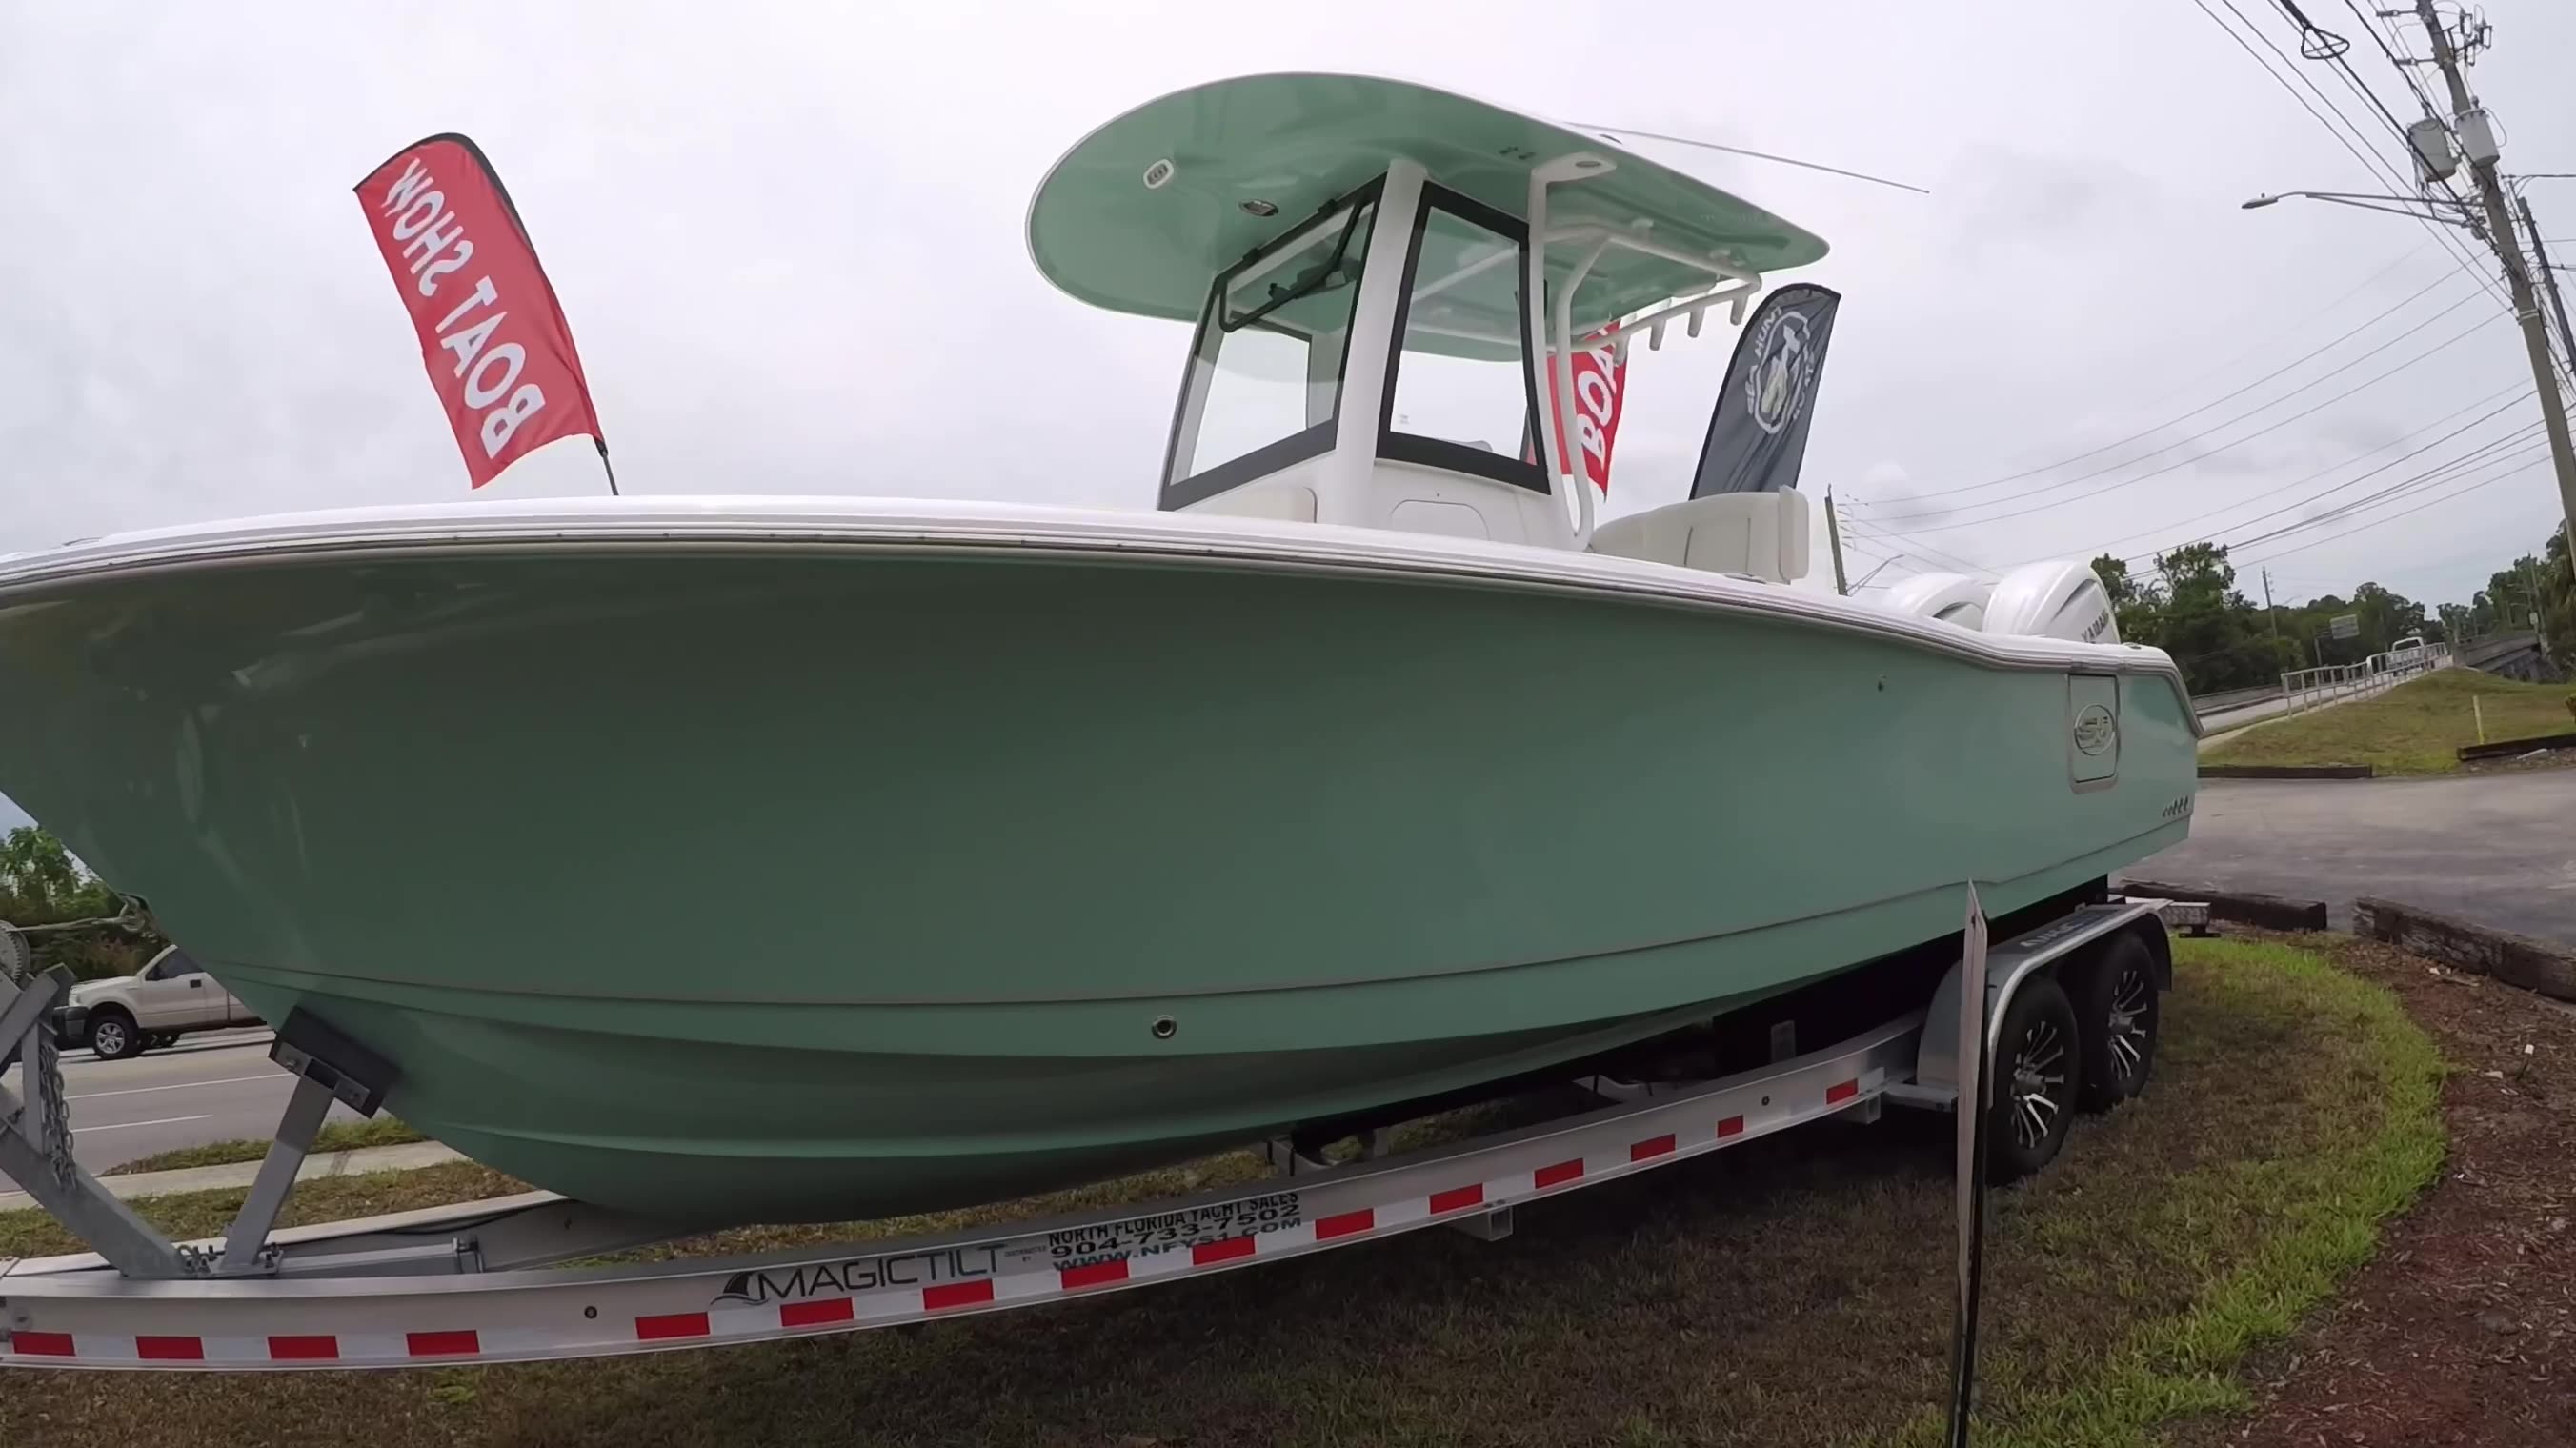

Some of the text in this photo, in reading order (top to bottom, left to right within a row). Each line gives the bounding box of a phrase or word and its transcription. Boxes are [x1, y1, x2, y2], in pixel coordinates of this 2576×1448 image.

[1049, 1192, 1298, 1247] NORTH FLORIDA YACHT SALES
[1051, 1204, 1301, 1258] 904-733-7502
[758, 1243, 1006, 1300] MAGICTILT
